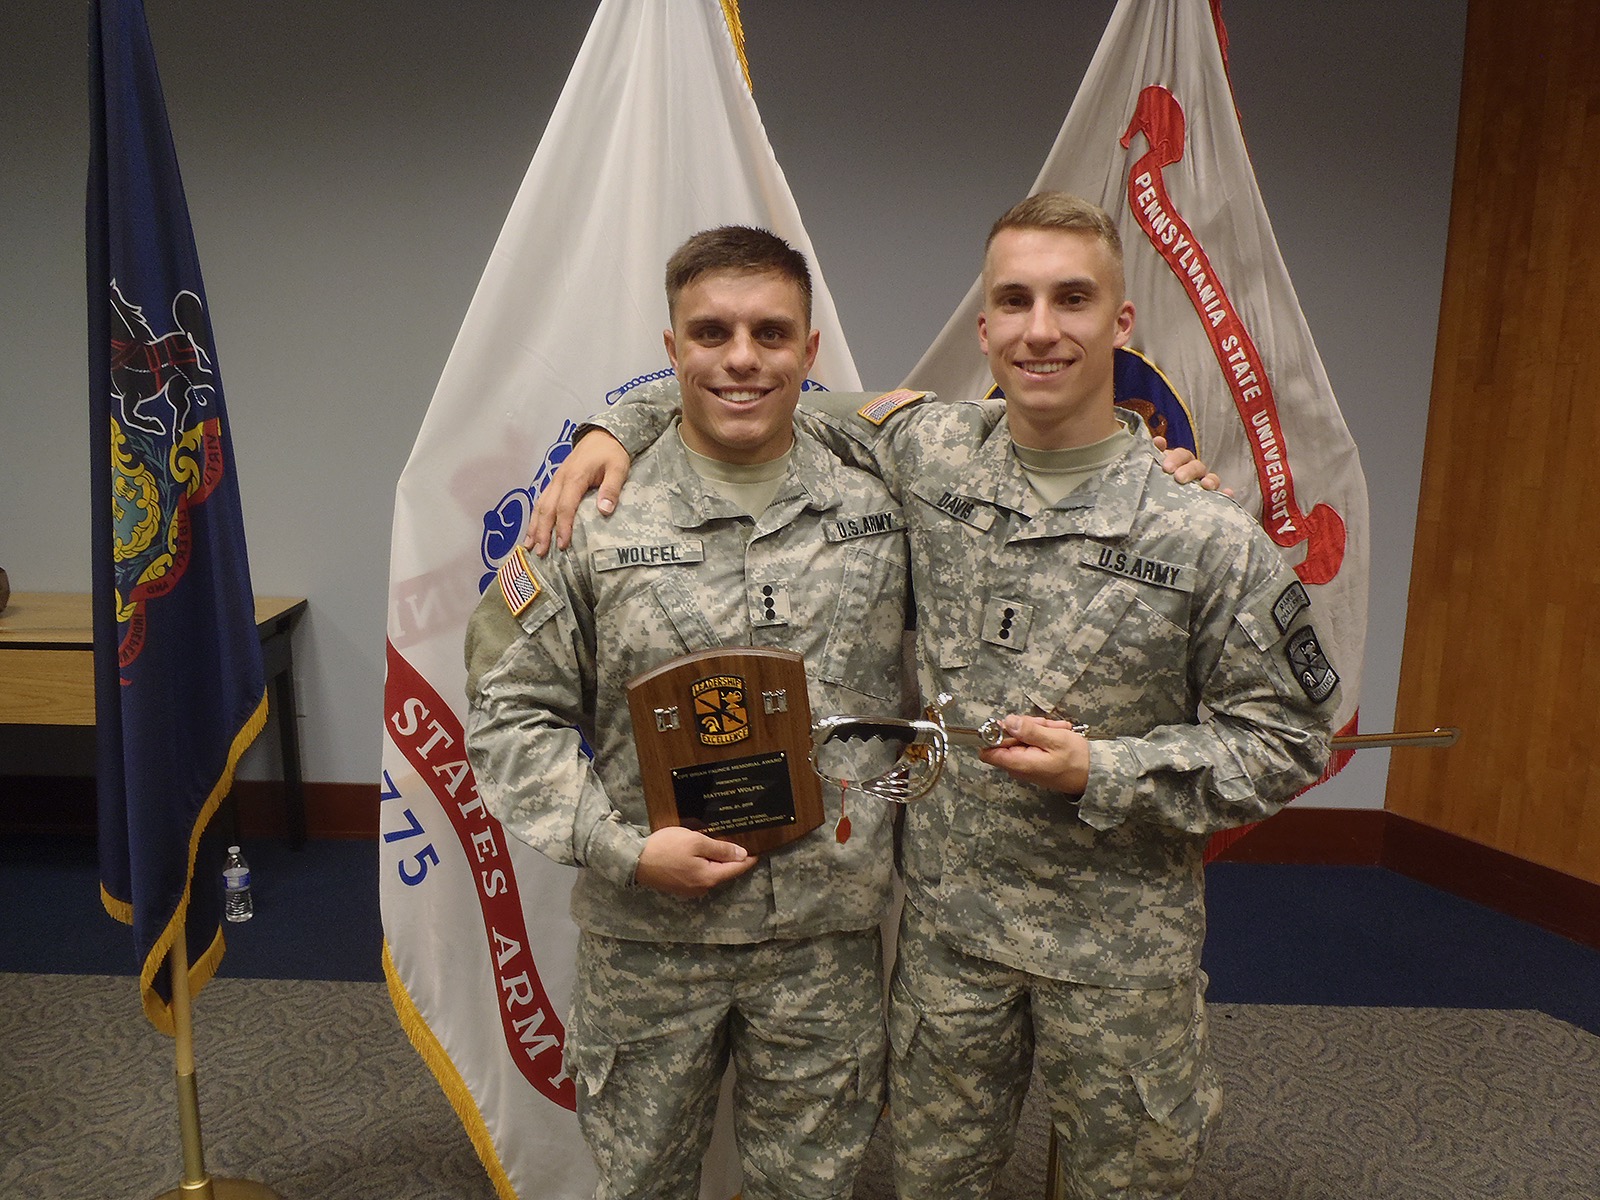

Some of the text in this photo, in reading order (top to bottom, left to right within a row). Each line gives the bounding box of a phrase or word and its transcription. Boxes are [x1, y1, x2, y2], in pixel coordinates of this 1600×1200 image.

[1134, 170, 1297, 537] PENNSYLVANIA STATE UNIVERSITY
[936, 491, 975, 520] DAVIS
[616, 545, 681, 564] WOLFEL
[693, 677, 742, 697] LEADERSHIP
[702, 727, 748, 743] EXCELLENCE
[731, 761, 760, 771] MEMORIAL
[761, 757, 782, 765] AWARD
[391, 697, 508, 898] STATES
[492, 926, 570, 1090] ARMY
